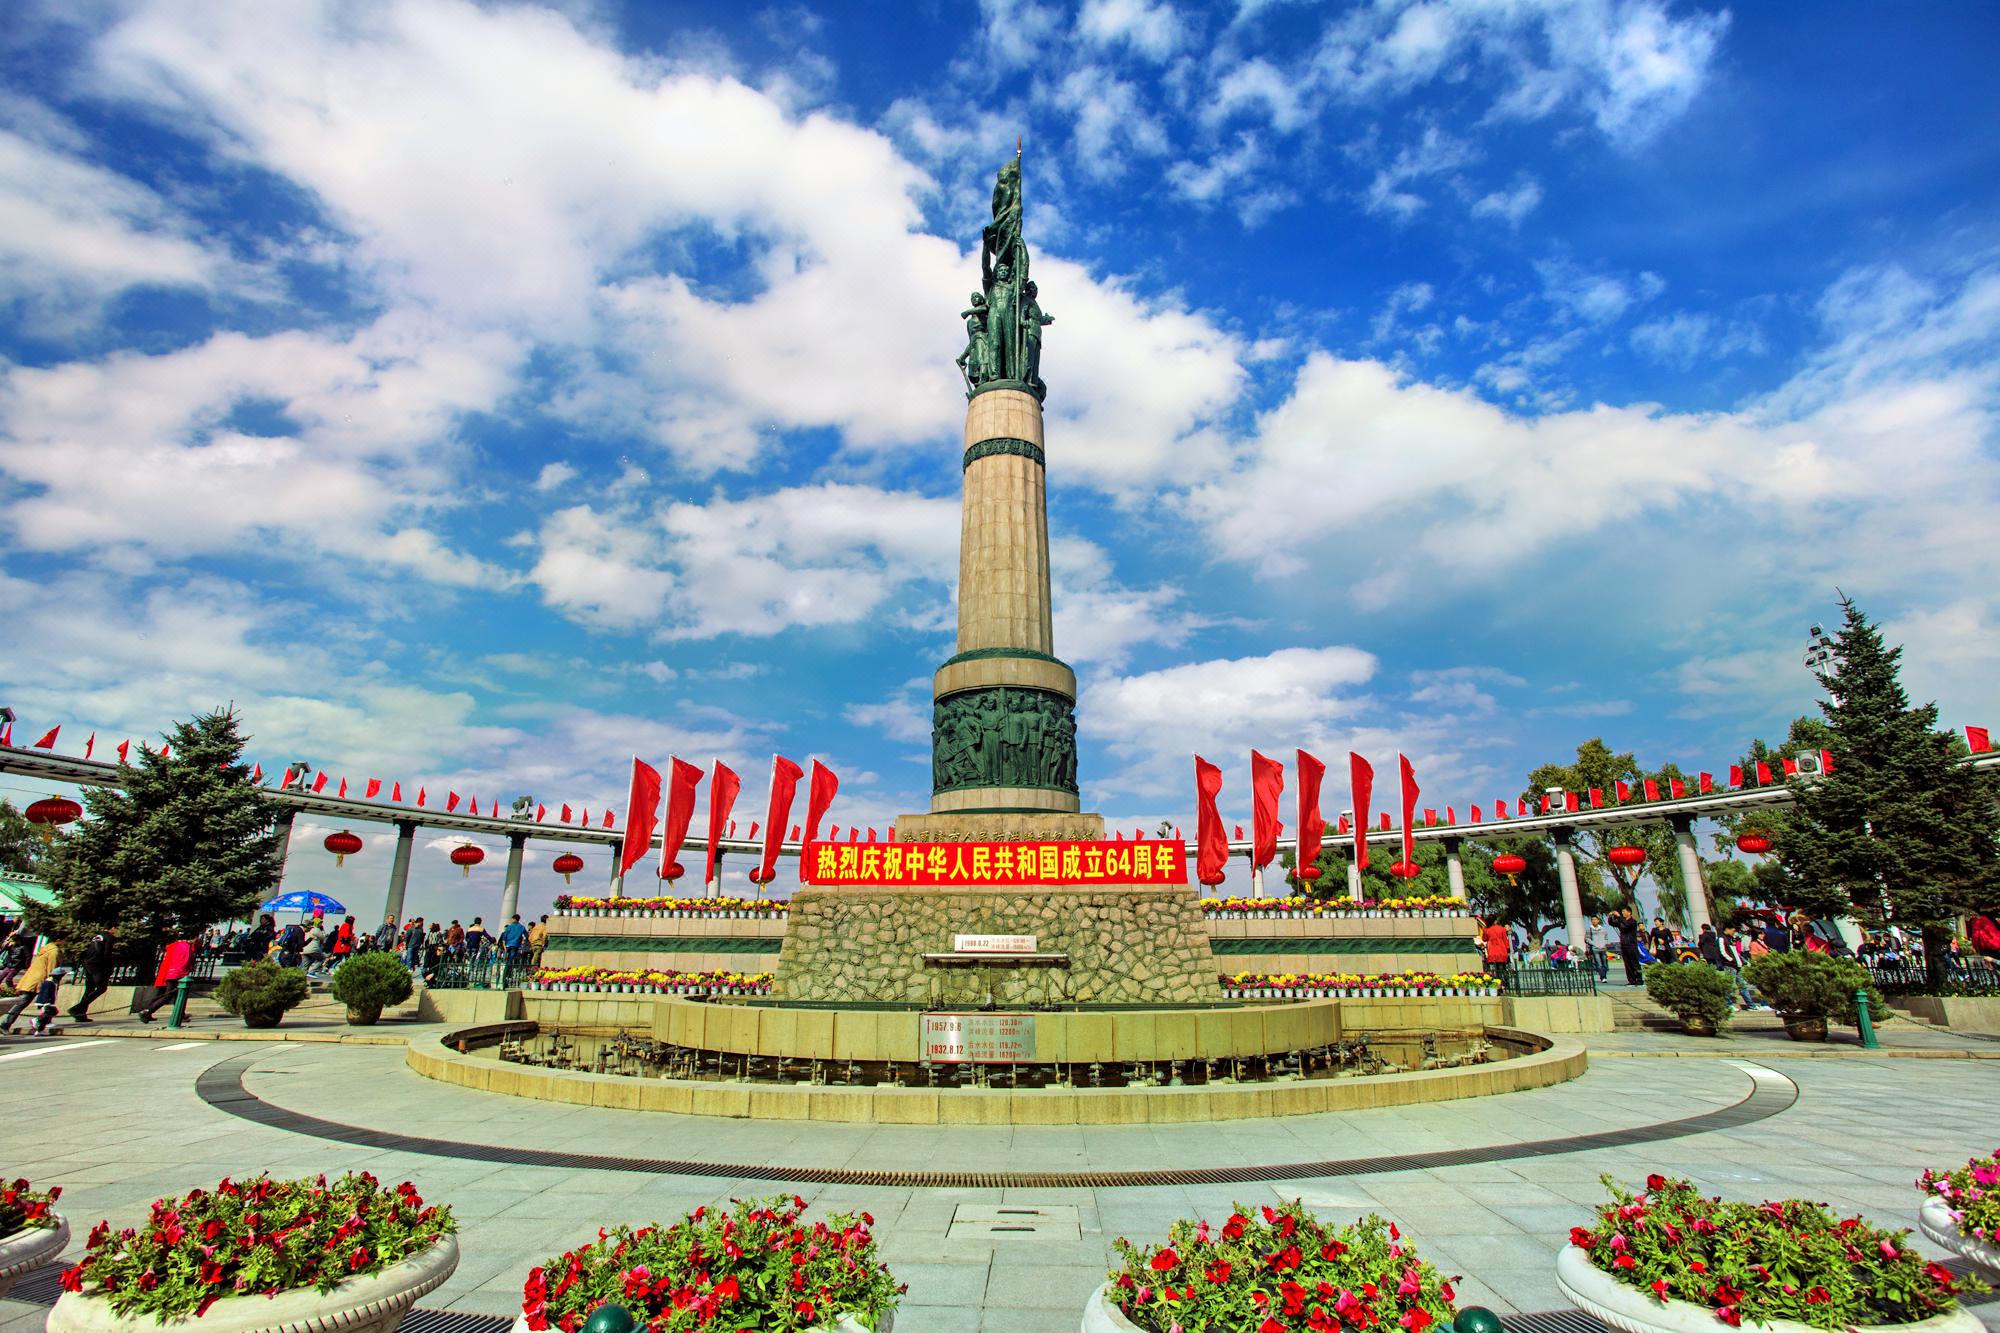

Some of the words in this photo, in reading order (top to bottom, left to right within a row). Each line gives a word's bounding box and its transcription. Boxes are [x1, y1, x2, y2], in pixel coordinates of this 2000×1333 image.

[816, 845, 1176, 880] 热烈庆祝中华人民共和国成立64周年
[931, 1044, 964, 1055] 1932.8.12
